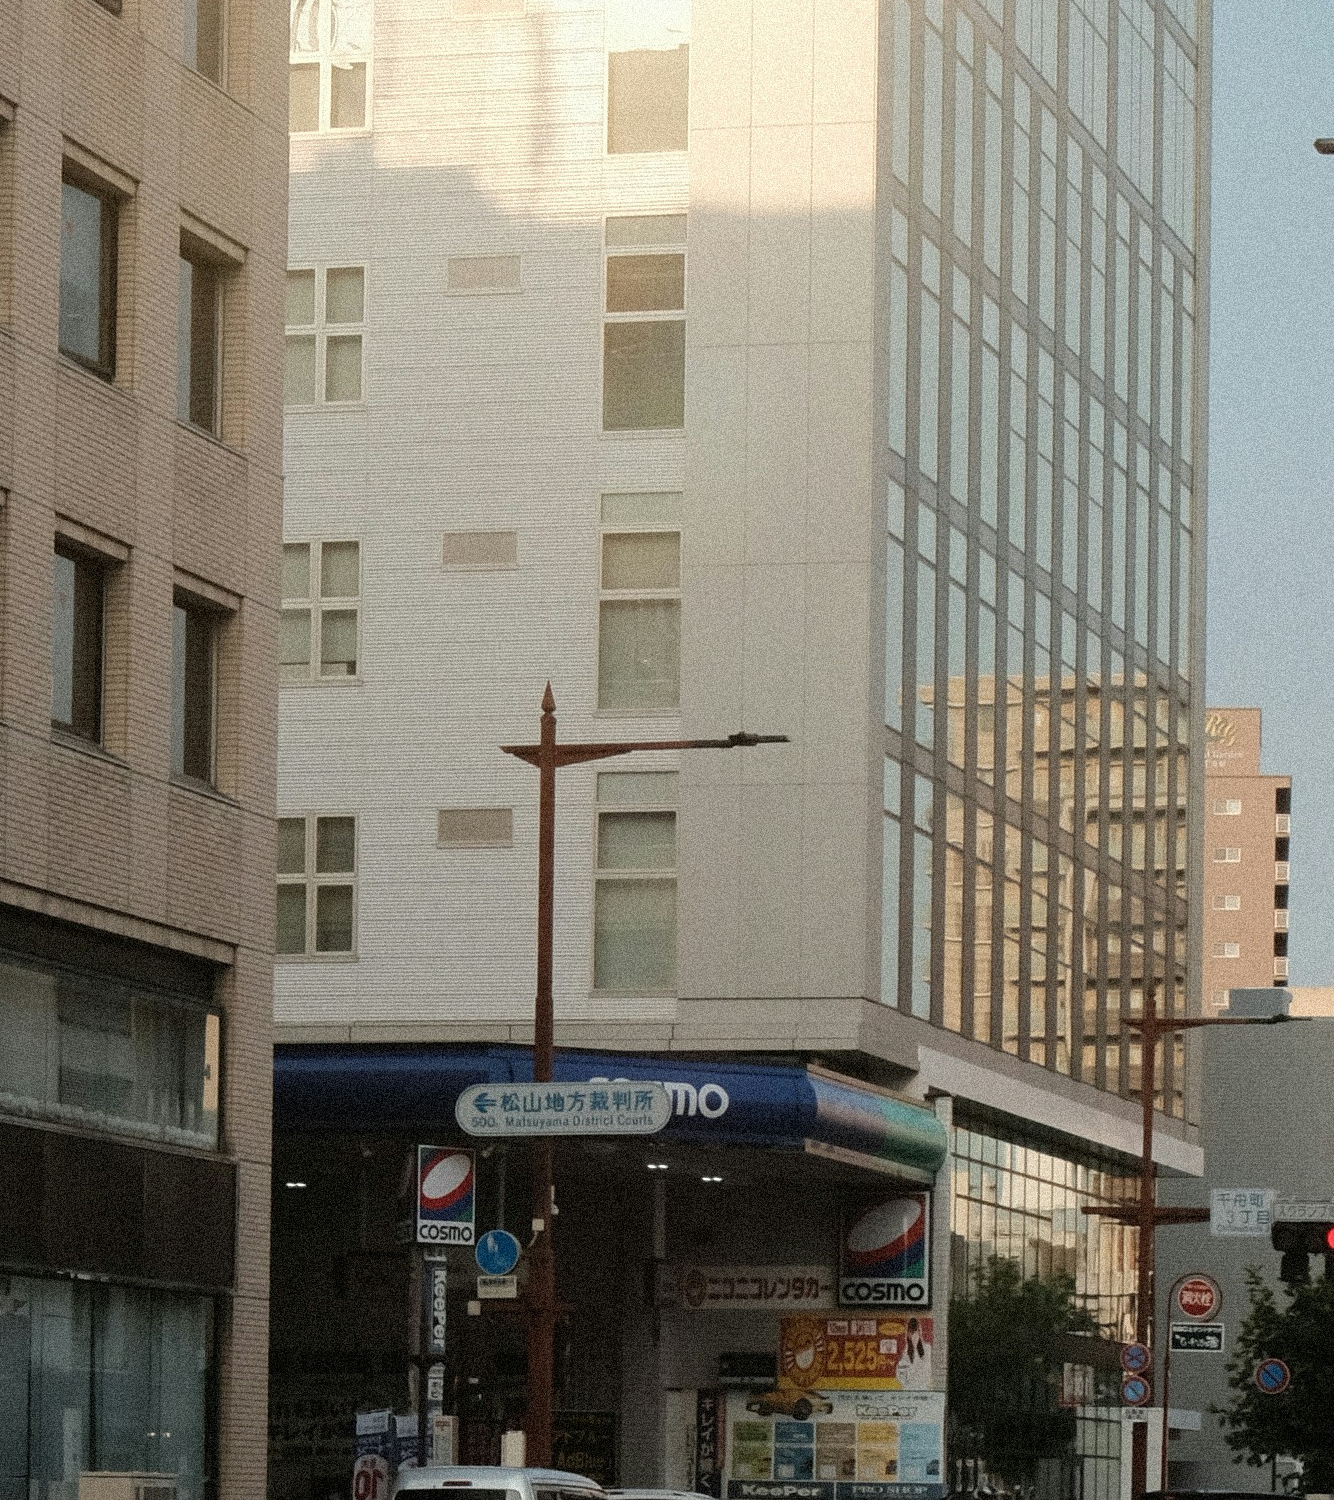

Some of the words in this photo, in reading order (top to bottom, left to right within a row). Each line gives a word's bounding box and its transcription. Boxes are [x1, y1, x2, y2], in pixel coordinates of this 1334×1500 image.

[500, 1090, 653, 1114] 松山地方裁判所
[505, 1114, 570, 1130] Matsuyama
[572, 1113, 615, 1127] District
[616, 1112, 653, 1126] Courts
[418, 1223, 473, 1243] COSMO
[707, 1276, 834, 1301] ニコニコレンタカー
[842, 1282, 926, 1302] COSMO
[433, 1269, 447, 1348] KeePer
[741, 1484, 824, 1498] KeePer
